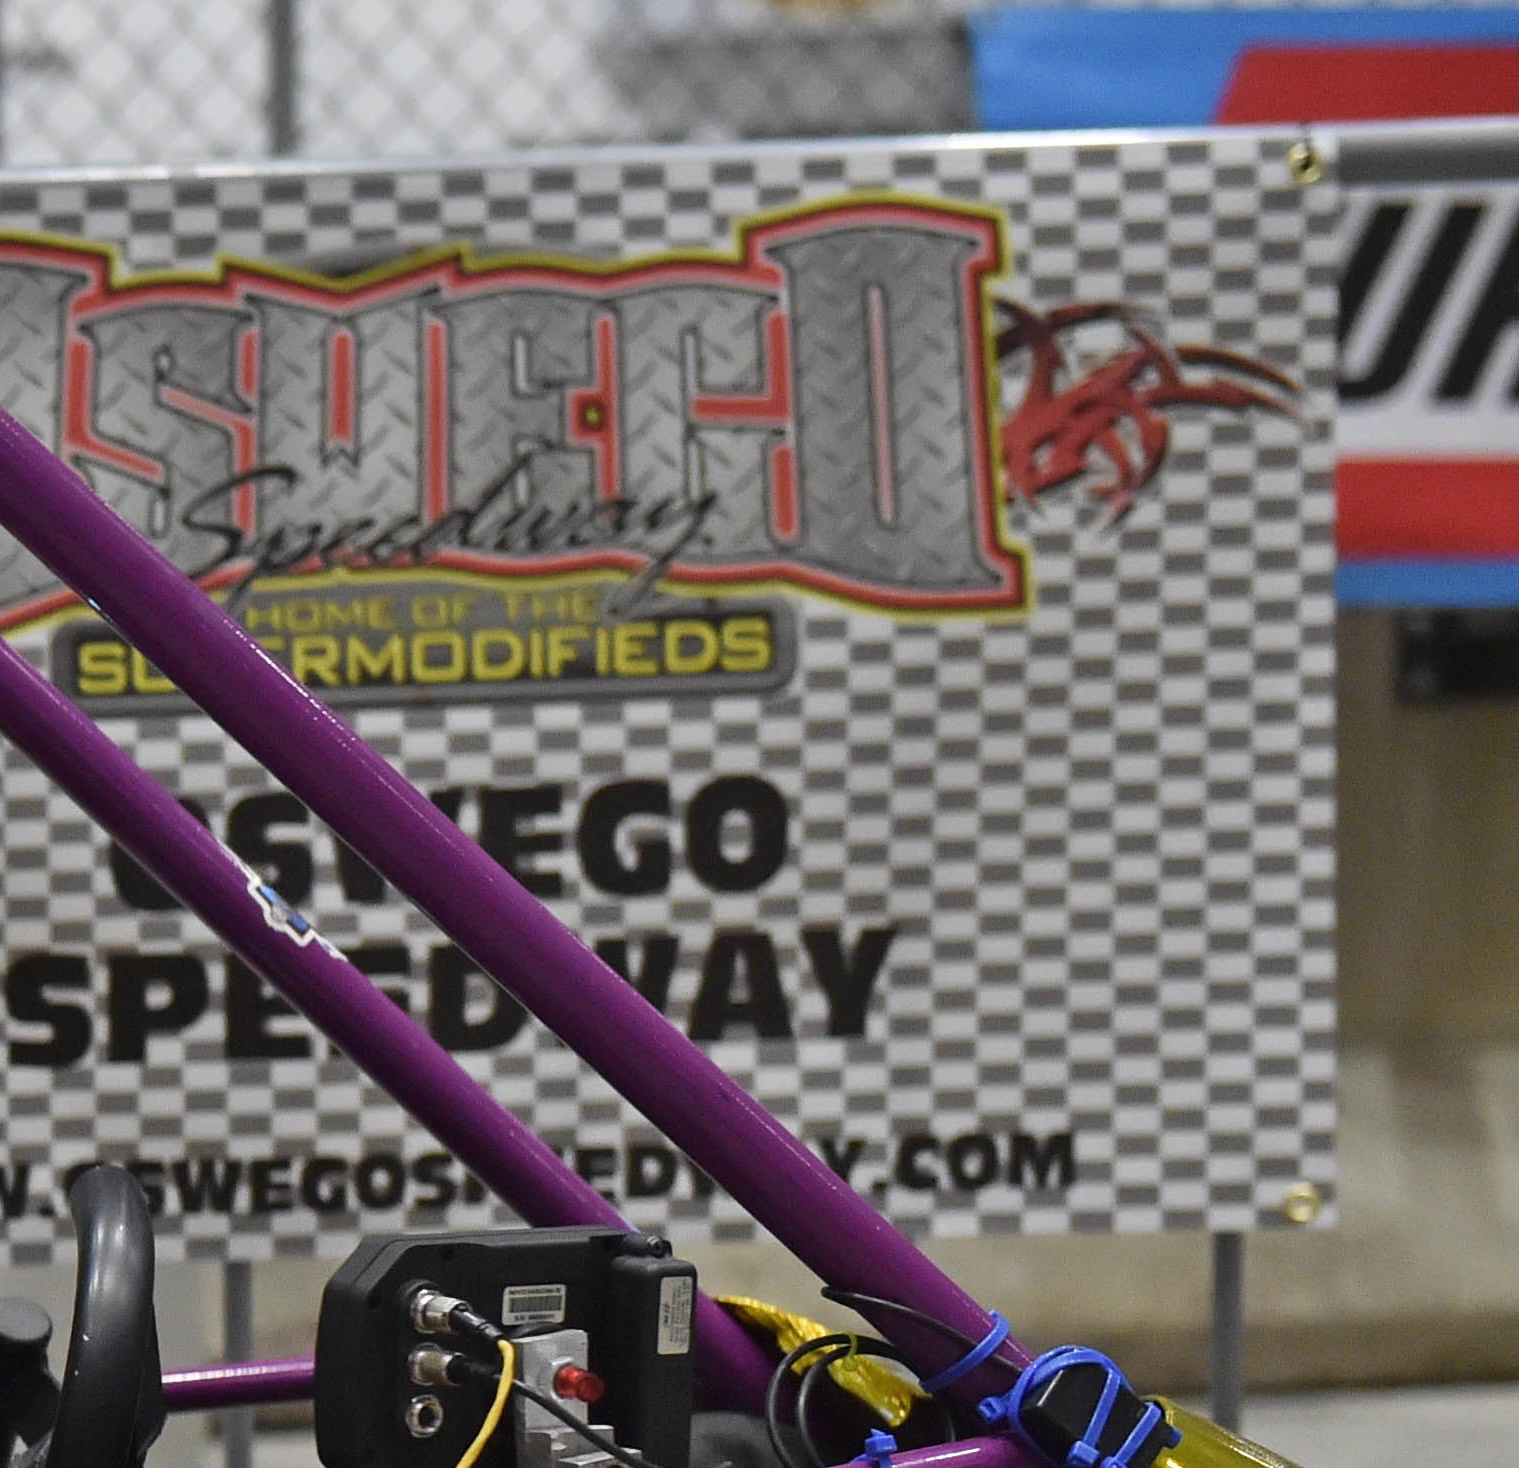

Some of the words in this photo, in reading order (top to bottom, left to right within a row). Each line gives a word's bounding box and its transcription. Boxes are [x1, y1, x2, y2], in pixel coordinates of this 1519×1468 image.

[183, 445, 720, 620] Speedway
[246, 597, 397, 631] HOME
[412, 592, 476, 628] OF
